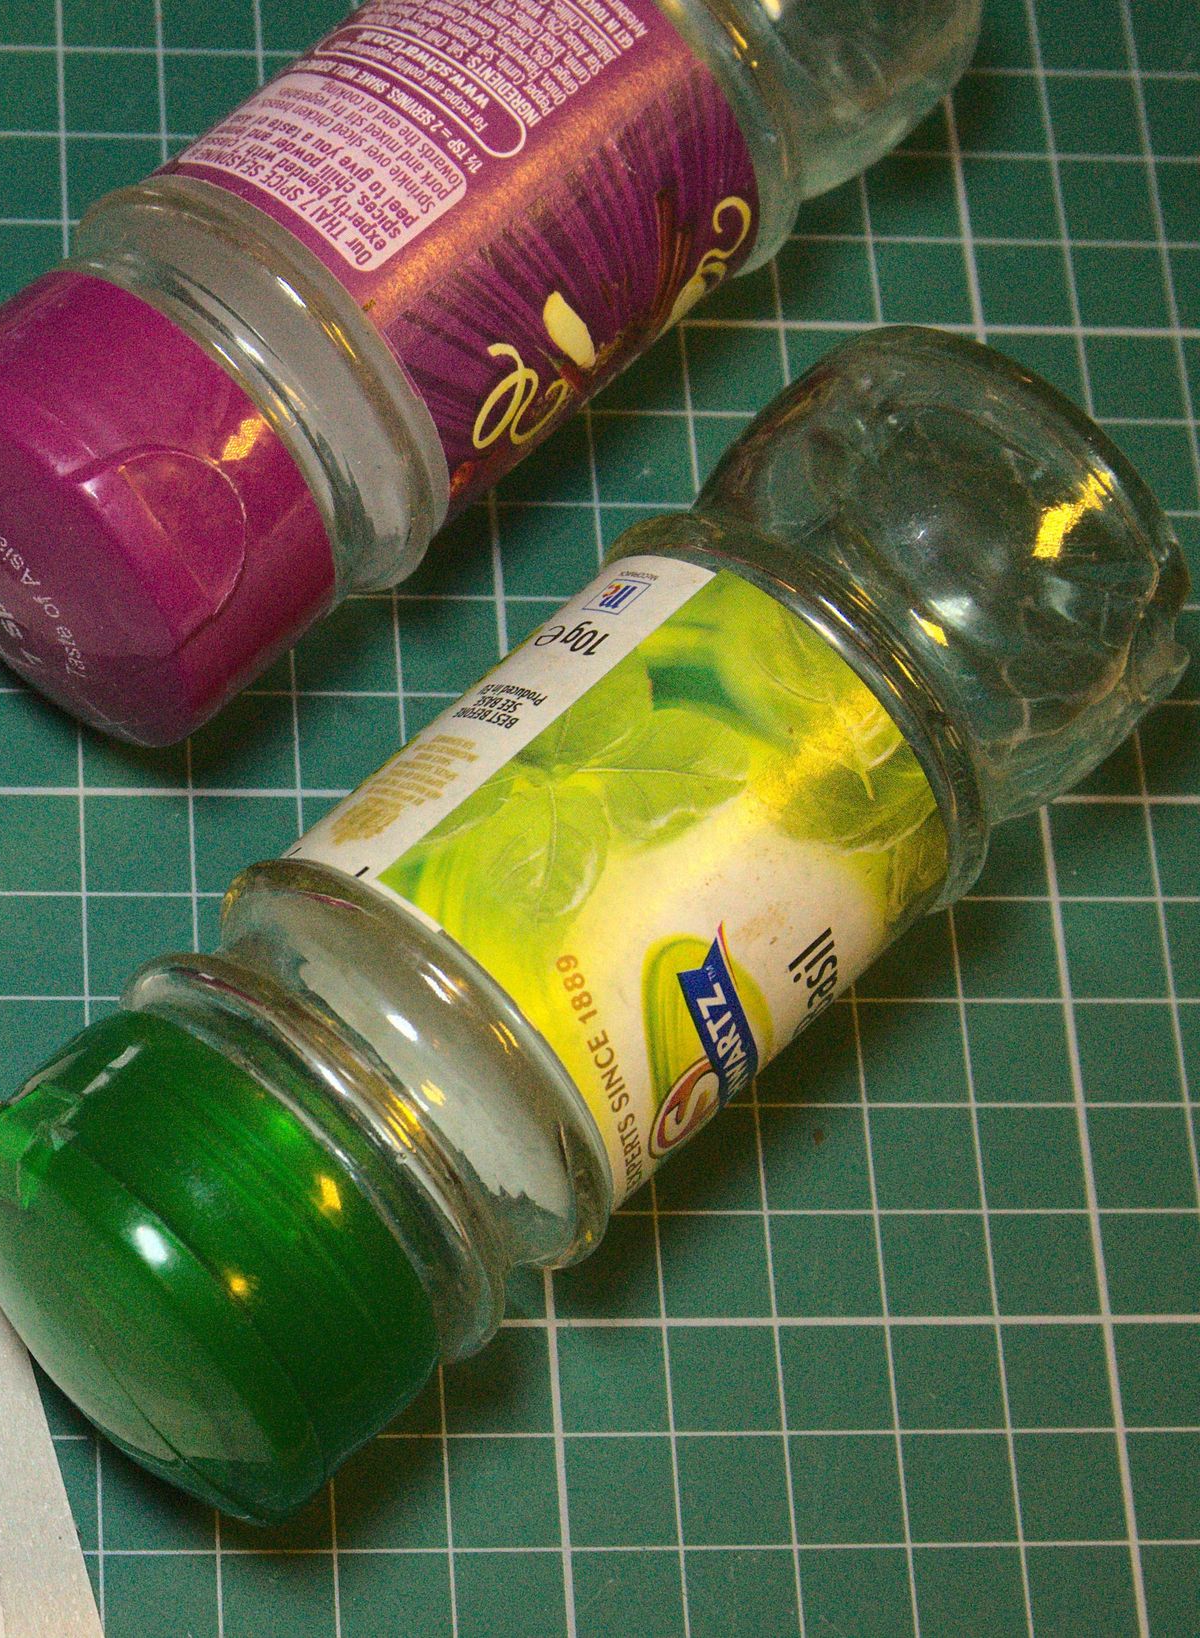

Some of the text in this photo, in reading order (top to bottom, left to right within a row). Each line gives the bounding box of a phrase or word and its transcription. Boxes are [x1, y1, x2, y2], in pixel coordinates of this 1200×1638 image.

[502, 24, 534, 48] Dried
[603, 17, 618, 32] IN
[537, 30, 565, 55] Dried
[561, 30, 588, 55] Anise
[578, 24, 616, 63] Jalapeno
[614, 27, 634, 48] GET
[391, 55, 427, 79] cooking
[583, 53, 604, 74] Star
[353, 70, 390, 92] SHAKE
[421, 75, 445, 91] and
[463, 53, 542, 127] INGREDIENTS:
[538, 71, 566, 105] Onion,
[548, 62, 579, 95] Ginger
[327, 99, 347, 117] fry
[358, 100, 378, 114] of
[440, 86, 475, 117] recipes
[522, 79, 554, 116] Pepper,
[248, 115, 269, 126] of
[264, 115, 302, 141] taste
[291, 104, 334, 129] chicken
[342, 109, 368, 129] stir
[370, 107, 401, 129] end
[430, 118, 444, 131] 2
[470, 112, 488, 131] For
[242, 127, 272, 143] and
[300, 130, 314, 143] a
[327, 122, 366, 152] sliced
[355, 119, 402, 155] mixed
[396, 124, 421, 147] the
[446, 134, 471, 159] TSP
[243, 145, 276, 165] with
[268, 135, 325, 168] powder
[310, 137, 344, 161] you
[355, 139, 393, 168] over
[396, 148, 425, 173] and
[338, 153, 374, 184] give
[417, 141, 463, 189] towards
[258, 168, 305, 202] SPICE
[272, 156, 331, 200] blended
[318, 162, 356, 195] chilli
[367, 178, 387, 200] to
[385, 164, 437, 215] Sprinkle
[418, 170, 455, 202] pork
[298, 194, 314, 211] 7
[354, 189, 401, 240] spices,
[380, 195, 420, 230] peel
[309, 203, 346, 241] THAI
[325, 192, 387, 252] expertly
[343, 237, 373, 267] Our
[493, 681, 504, 691] in
[498, 683, 547, 706] Produced
[472, 694, 522, 714] SEE BASE
[452, 707, 518, 729] BEST BEFORE
[554, 955, 597, 1024] 1889
[586, 1029, 628, 1113] SINCE
